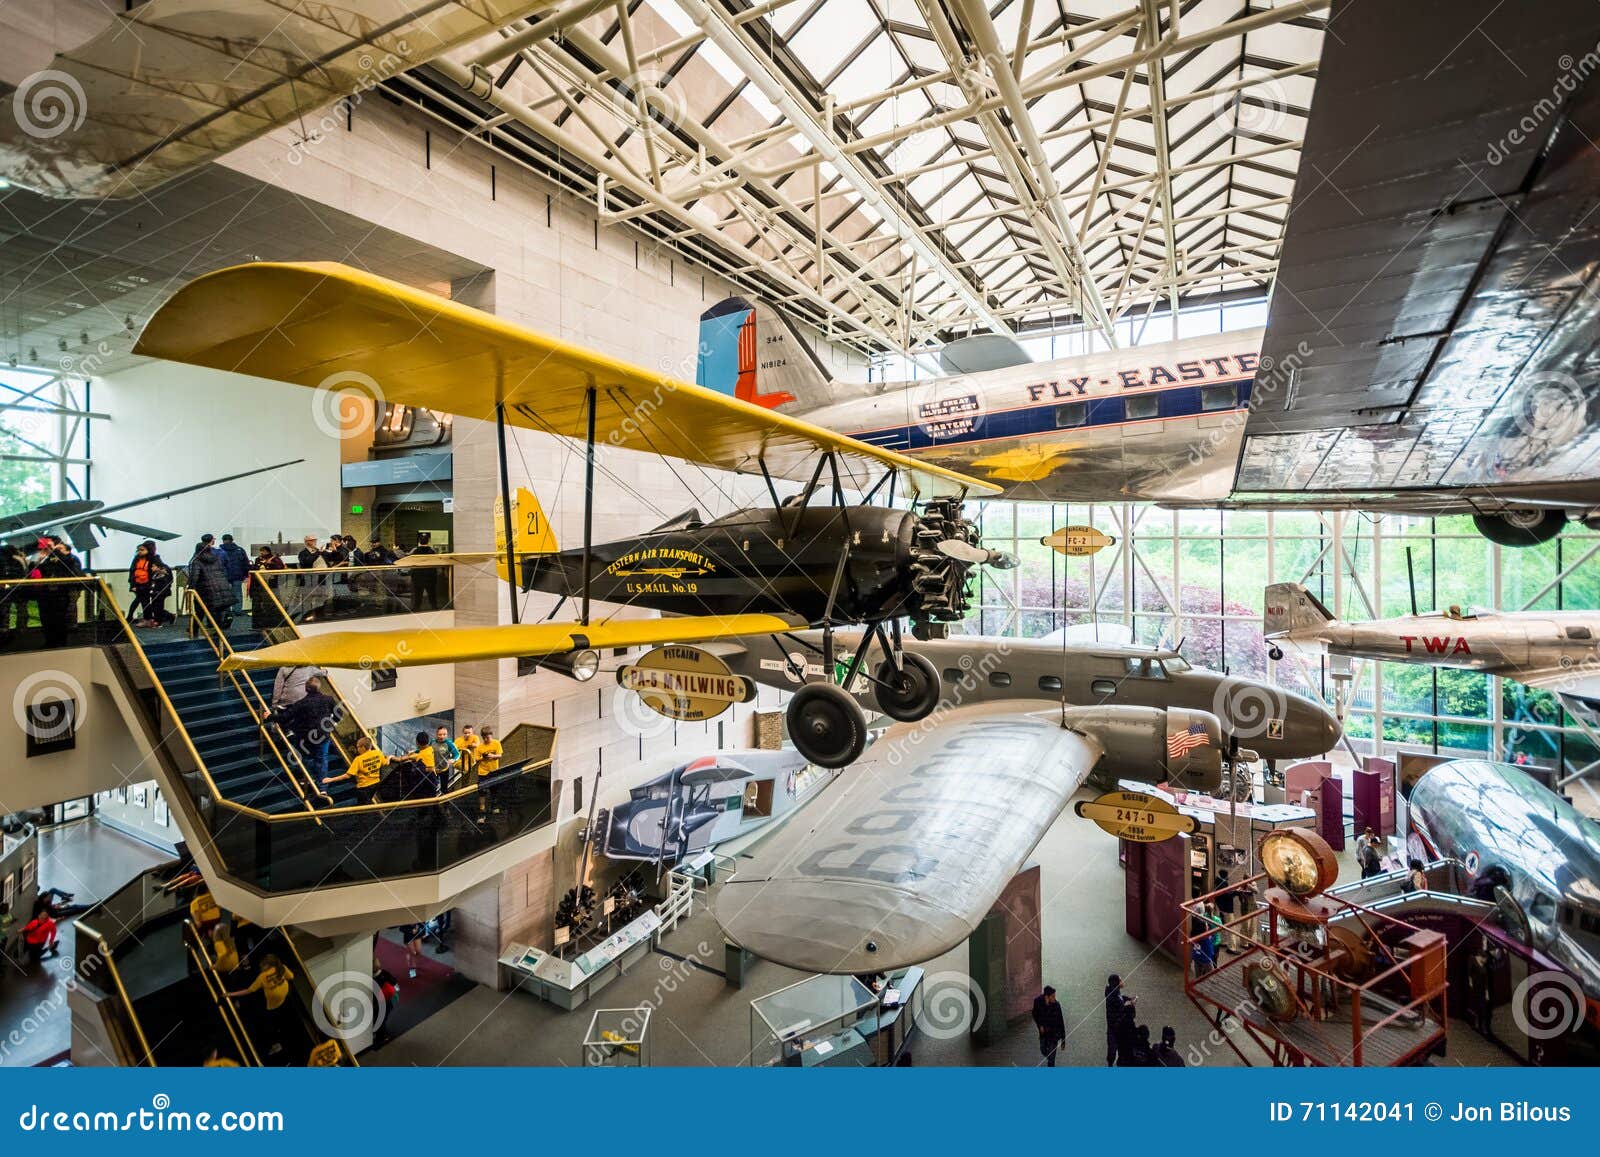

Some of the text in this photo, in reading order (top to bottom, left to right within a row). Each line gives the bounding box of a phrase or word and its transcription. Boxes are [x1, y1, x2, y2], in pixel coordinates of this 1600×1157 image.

[766, 335, 783, 344] 344
[920, 408, 948, 417] SILVER
[926, 419, 973, 432] EASTERN
[527, 511, 539, 535] 21
[1068, 537, 1087, 545] FC-2
[607, 551, 639, 575] EASTERN
[641, 548, 657, 560] AIR
[659, 548, 703, 566] TRANSPORT
[1399, 635, 1472, 655] TWA
[663, 648, 700, 662] PITCAIRN
[631, 669, 735, 698] PA-5 MAILWING
[1117, 809, 1155, 825] 247-D
